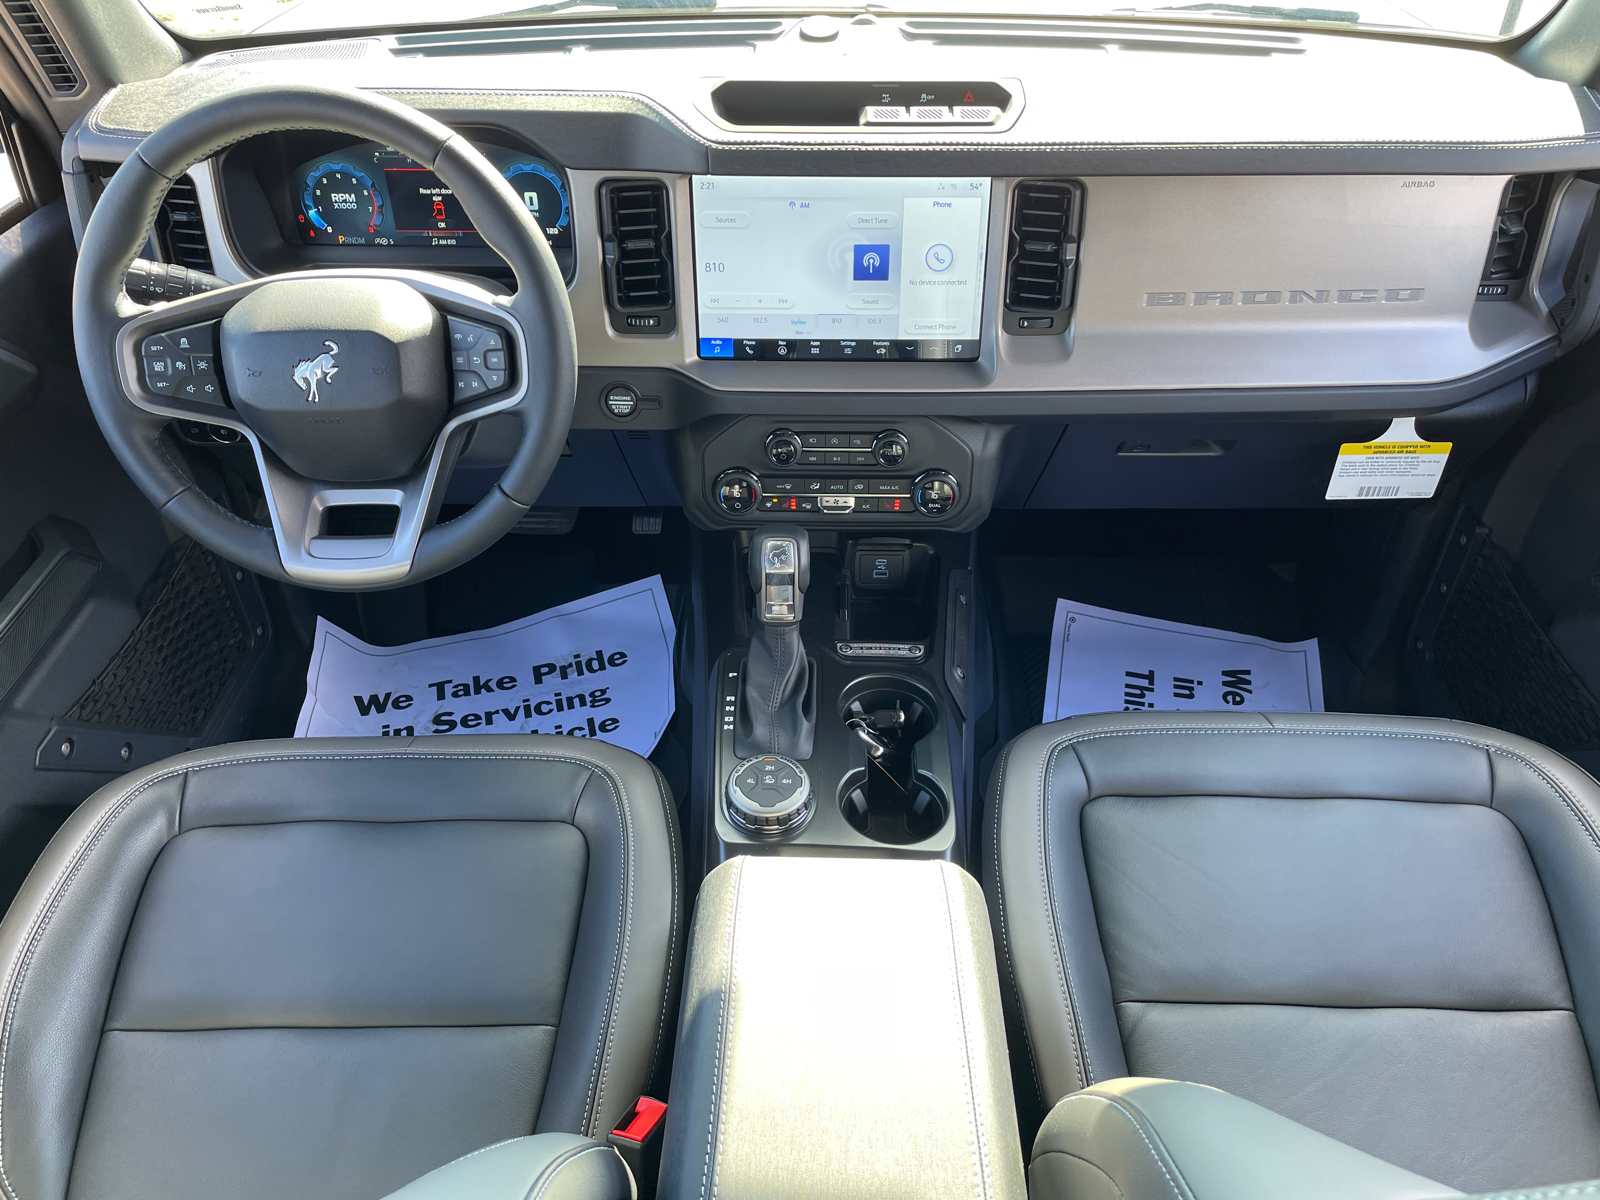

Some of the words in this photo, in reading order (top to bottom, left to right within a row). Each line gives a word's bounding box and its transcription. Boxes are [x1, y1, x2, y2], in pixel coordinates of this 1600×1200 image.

[700, 182, 715, 190] 2:21
[331, 194, 356, 202] RPM
[524, 192, 539, 210] 0
[704, 262, 725, 273] 810
[1142, 288, 1426, 307] BRONCO
[352, 691, 414, 716] We
[428, 674, 518, 702] Take
[531, 650, 628, 685] Pride
[1123, 670, 1155, 711] Thi
[1173, 676, 1203, 700] in
[1221, 669, 1253, 706] We
[382, 724, 414, 736] in
[430, 686, 612, 734] Servicing
[780, 756, 804, 775] MODES
